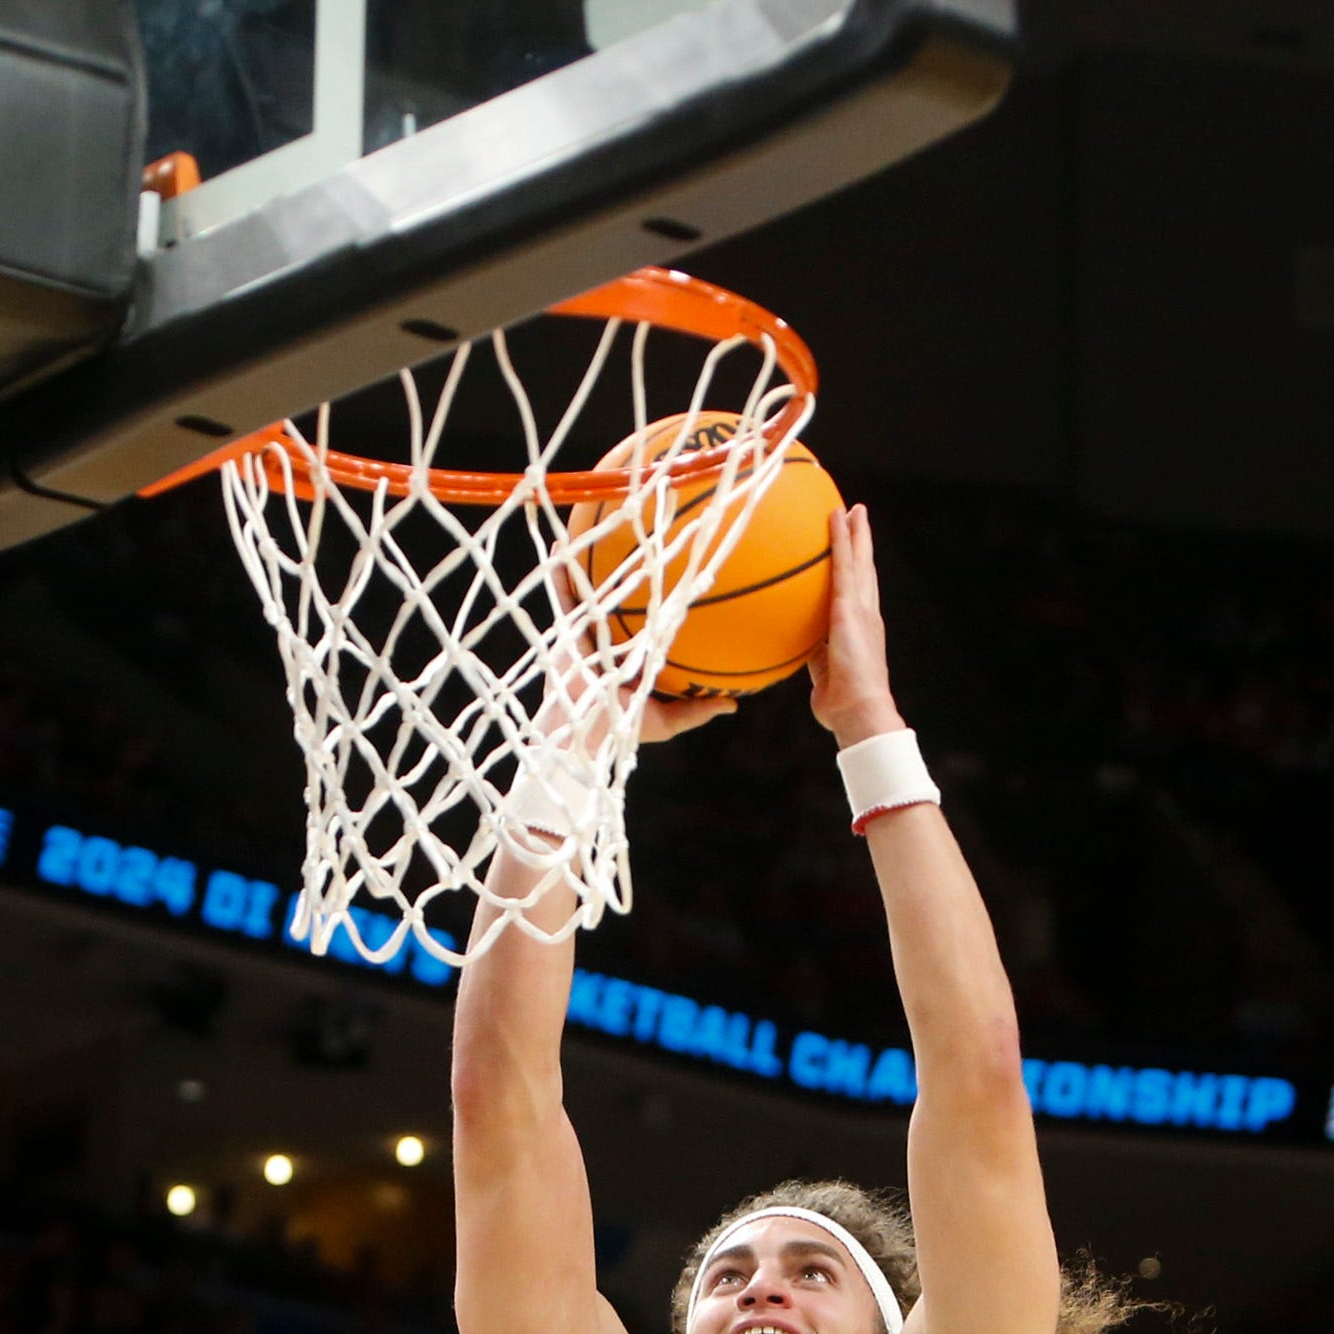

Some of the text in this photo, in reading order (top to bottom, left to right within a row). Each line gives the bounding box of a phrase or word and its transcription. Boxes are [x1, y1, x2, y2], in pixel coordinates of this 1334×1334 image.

[37, 825, 198, 917] 2024
[566, 967, 783, 1078] KETBALL
[788, 1030, 1296, 1132] CHAIONSHIP
